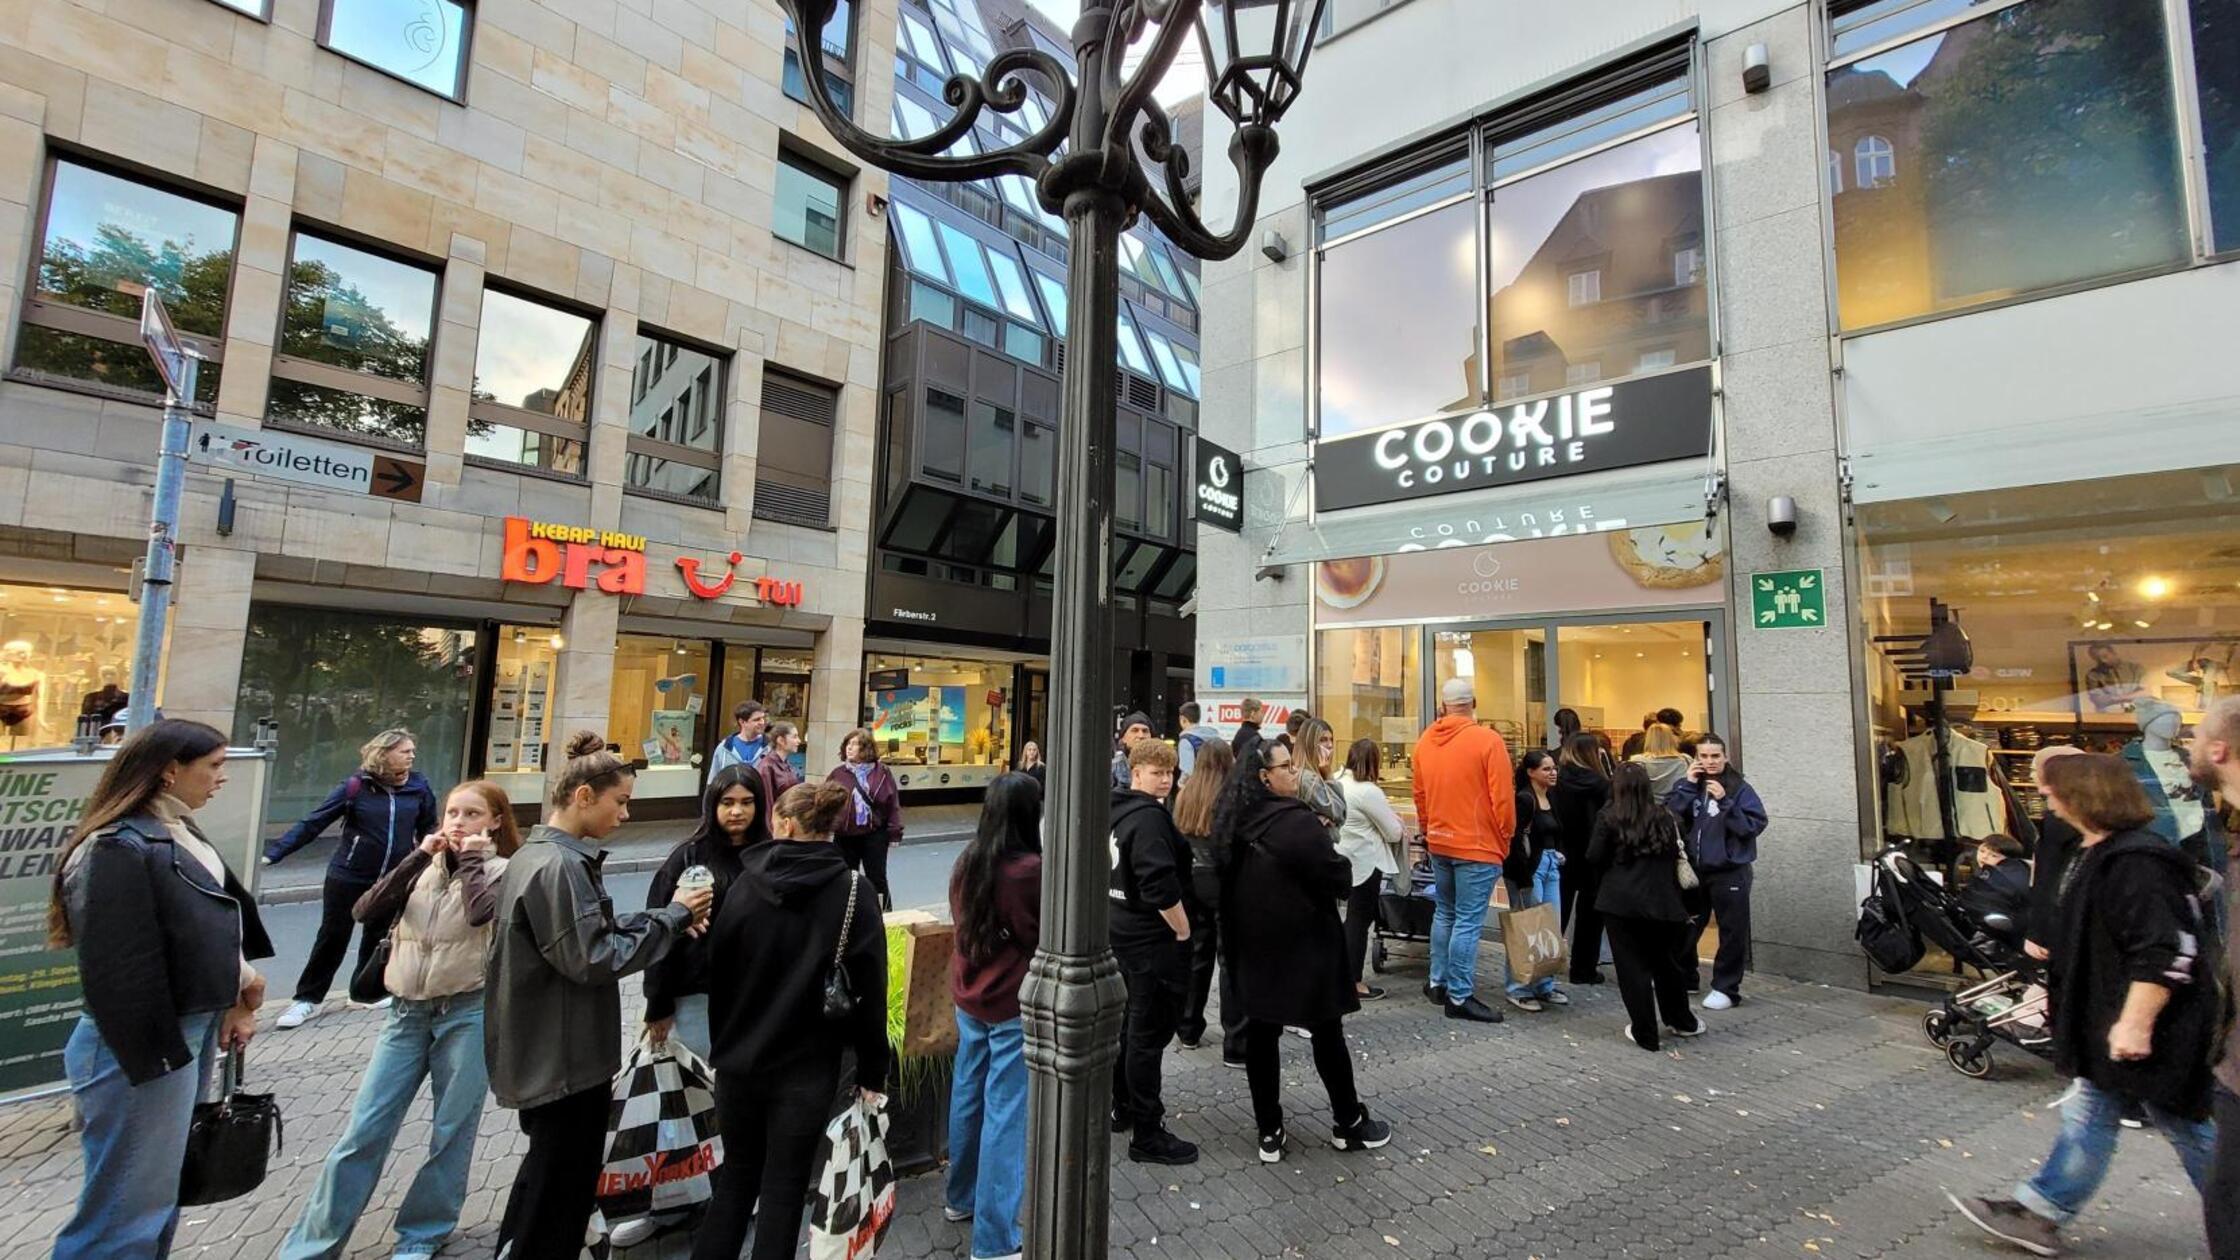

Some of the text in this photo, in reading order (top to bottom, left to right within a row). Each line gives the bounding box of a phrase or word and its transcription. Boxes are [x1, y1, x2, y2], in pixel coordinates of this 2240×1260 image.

[1375, 387, 1614, 469] COOKIE
[238, 439, 368, 482] Toiletten
[1399, 441, 1585, 488] COUTURE
[1198, 484, 1238, 511] COOKIE
[502, 516, 646, 596] bra
[532, 521, 647, 552] KEBAP HAUS
[1457, 578, 1519, 594] COOKIE
